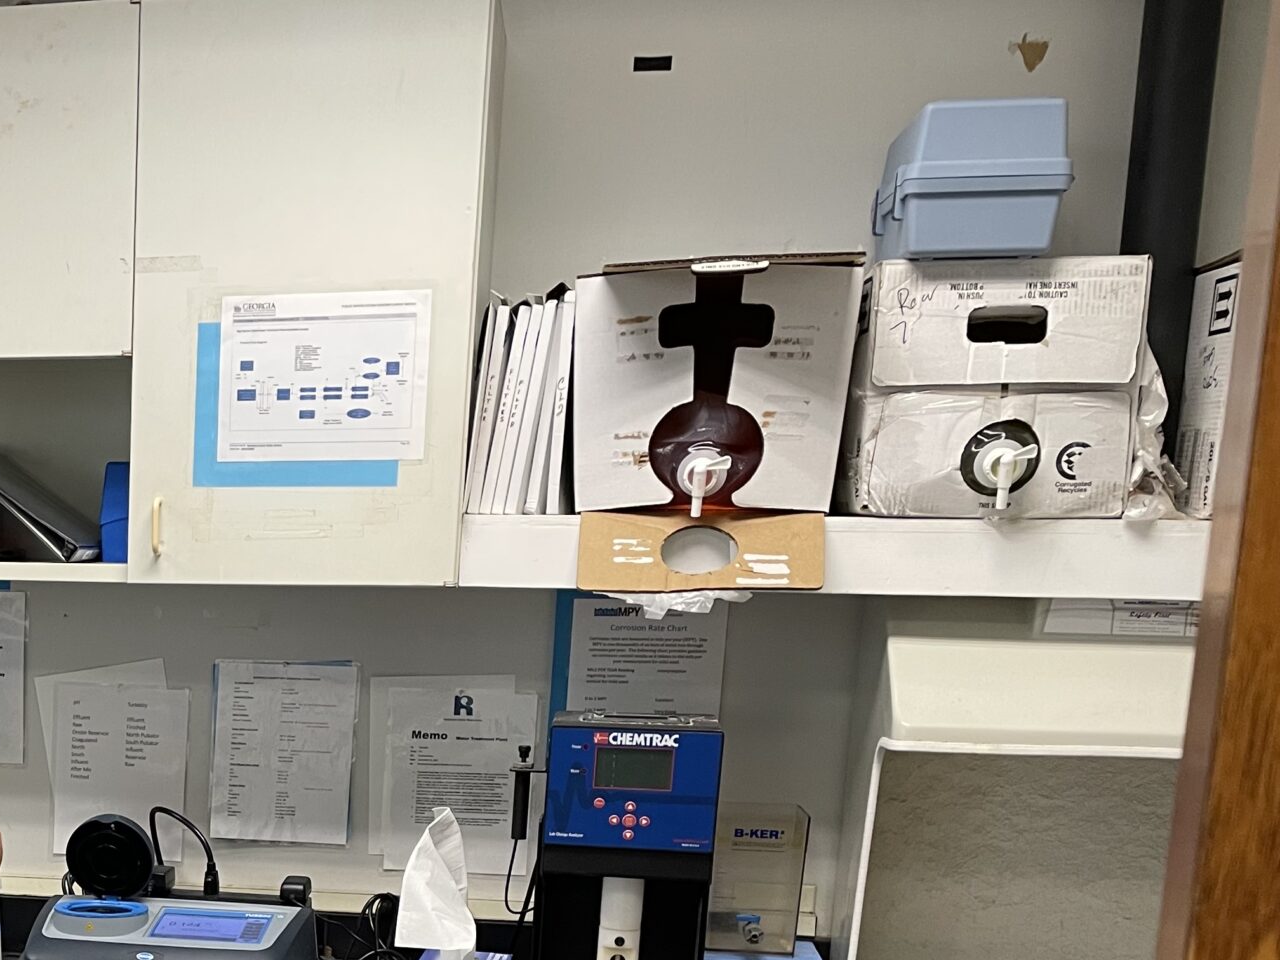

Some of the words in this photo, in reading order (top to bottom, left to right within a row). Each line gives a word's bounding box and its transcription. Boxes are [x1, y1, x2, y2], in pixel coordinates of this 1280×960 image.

[1055, 481, 1092, 490] Corrugated
[610, 624, 647, 632] Corrosion
[648, 624, 666, 632] Rate
[667, 624, 688, 632] Chart
[411, 730, 449, 740] Memo
[608, 732, 680, 748] CHEMTRAC
